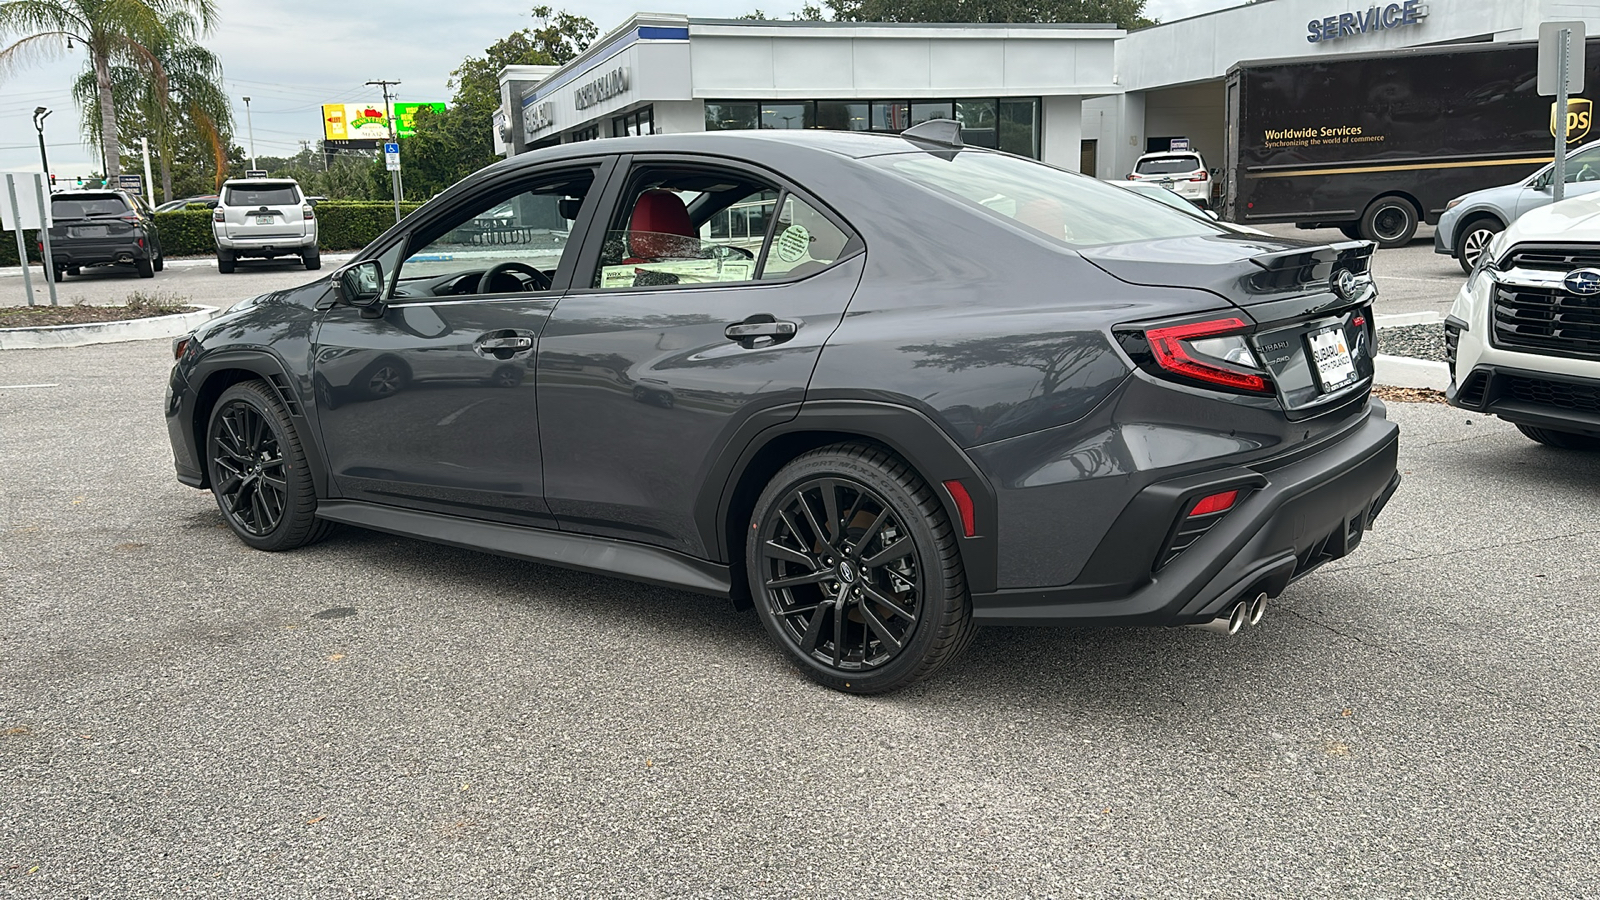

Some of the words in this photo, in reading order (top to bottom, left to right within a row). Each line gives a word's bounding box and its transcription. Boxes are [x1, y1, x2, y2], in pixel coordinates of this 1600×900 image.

[1306, 0, 1419, 43] SERVICE
[1553, 111, 1589, 137] ps
[1264, 127, 1318, 140] Worldwide
[1320, 125, 1362, 137] Services
[1264, 139, 1309, 148] Synchronizing
[1322, 136, 1341, 145] world
[1342, 135, 1349, 143] of
[1350, 135, 1385, 143] commerce
[1256, 341, 1288, 352] SUBARU
[1313, 344, 1338, 363] SUBARU
[880, 480, 898, 493] GT
